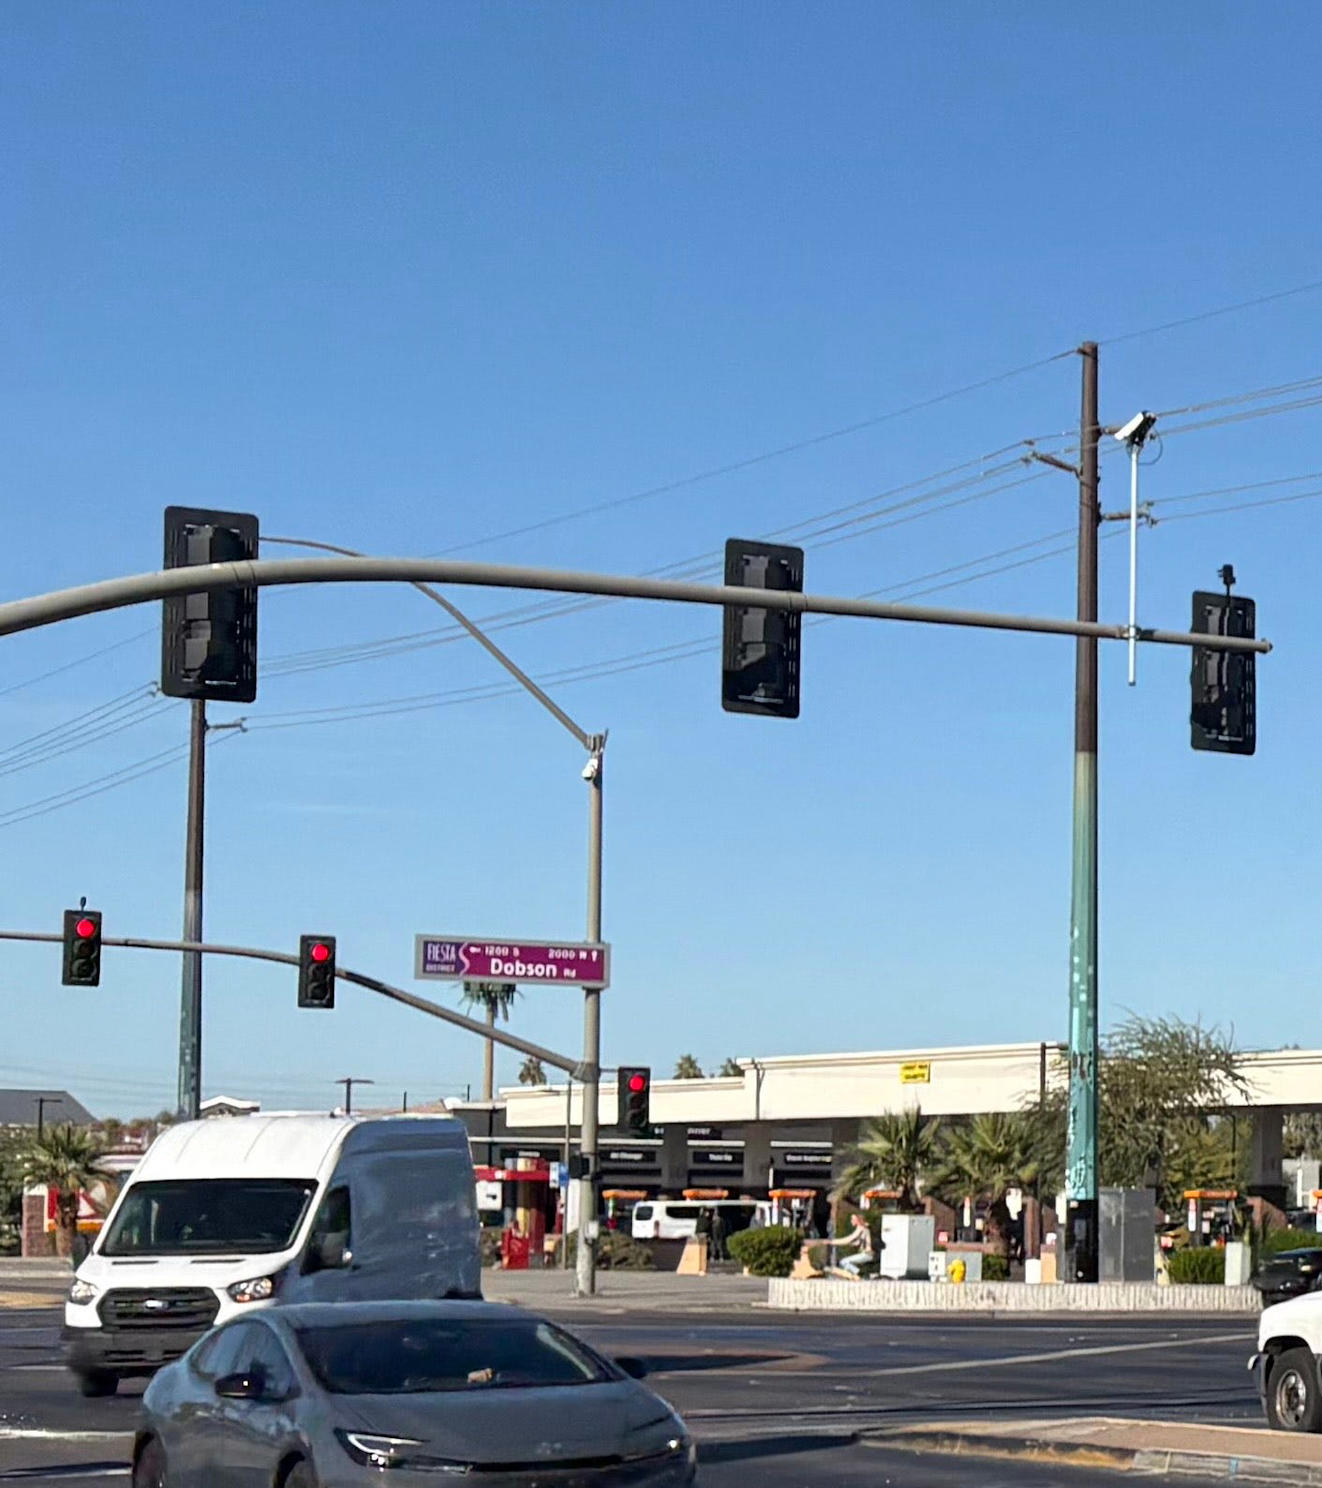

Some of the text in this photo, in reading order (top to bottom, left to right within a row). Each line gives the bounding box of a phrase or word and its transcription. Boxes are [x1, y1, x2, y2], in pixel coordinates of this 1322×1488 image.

[427, 943, 456, 961] FIESTA
[490, 958, 576, 978] Dobson Rd
